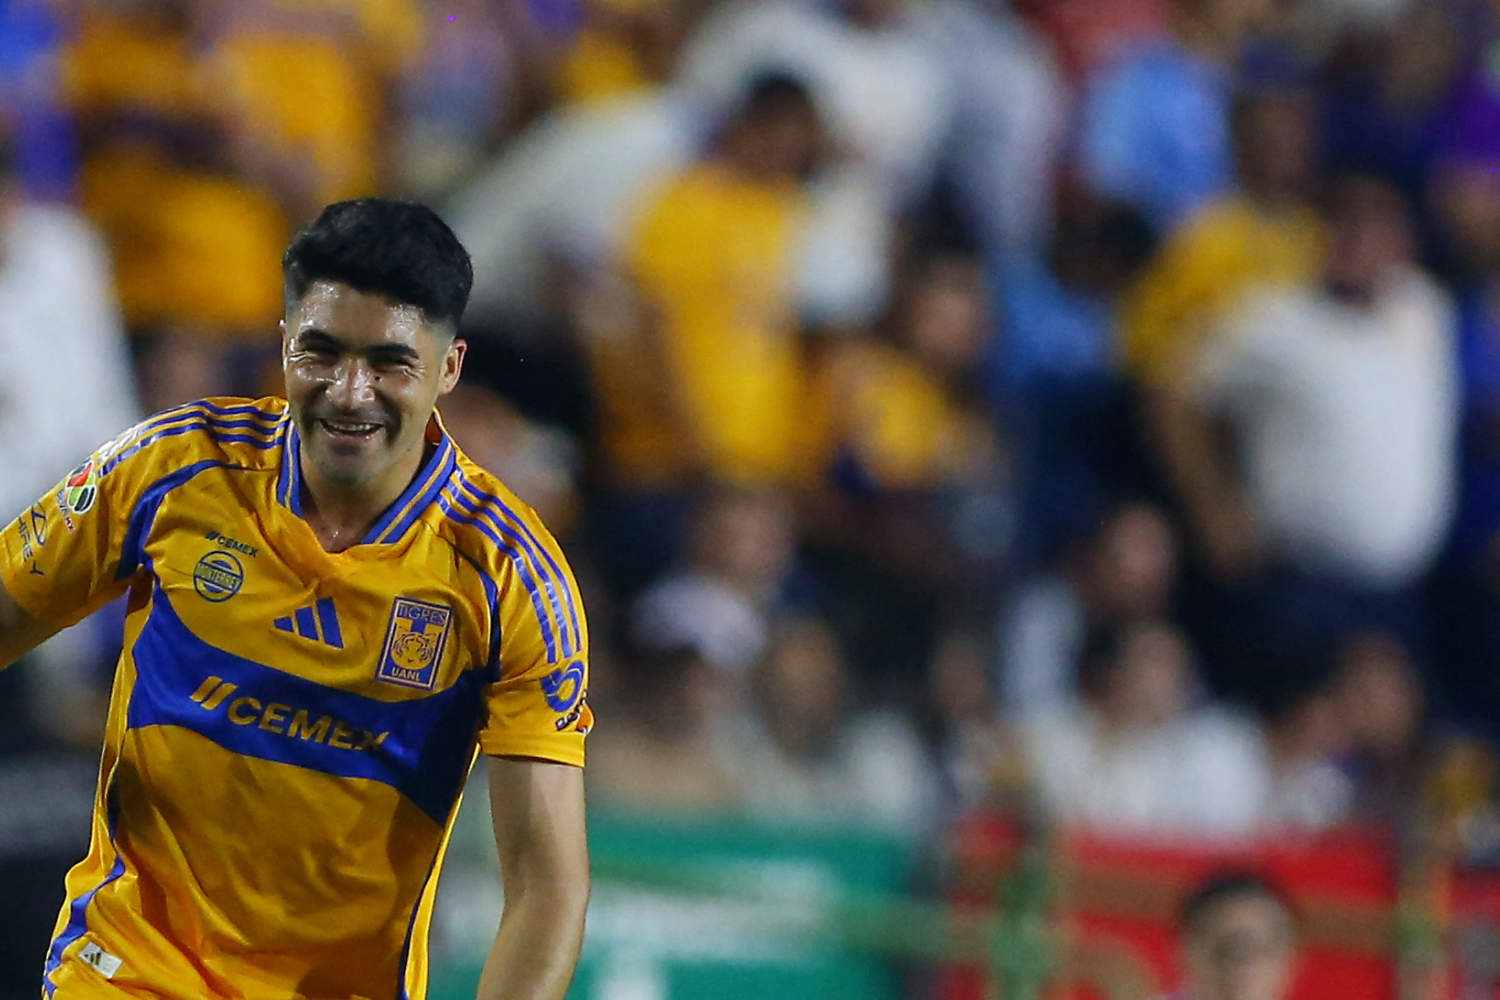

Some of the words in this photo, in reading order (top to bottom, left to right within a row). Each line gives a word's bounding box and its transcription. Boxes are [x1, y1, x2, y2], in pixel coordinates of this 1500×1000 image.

[18, 516, 45, 576] HIREY
[218, 536, 258, 557] CEMEX
[399, 604, 447, 625] TIGRES
[391, 666, 421, 682] UANL
[227, 697, 390, 750] CEMEX
